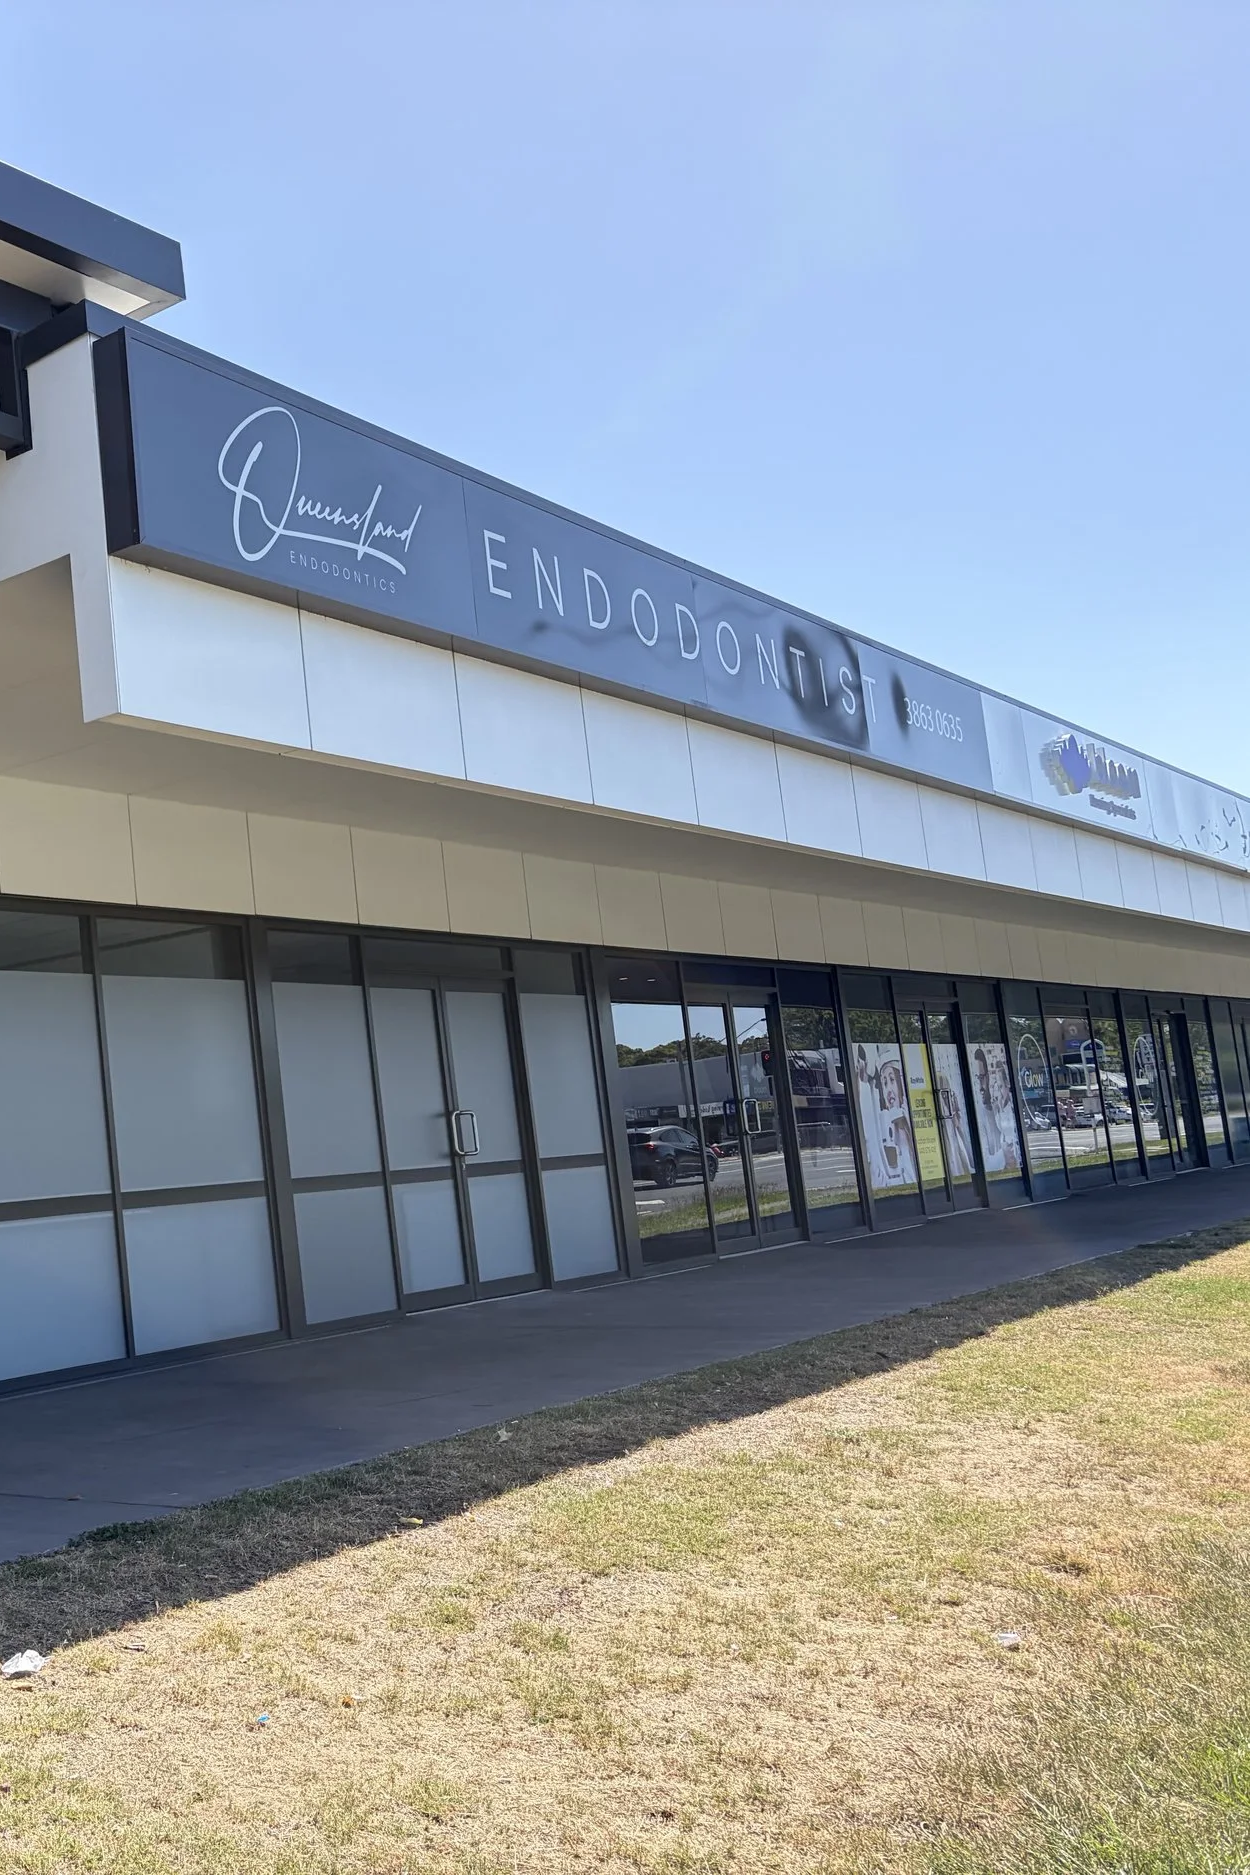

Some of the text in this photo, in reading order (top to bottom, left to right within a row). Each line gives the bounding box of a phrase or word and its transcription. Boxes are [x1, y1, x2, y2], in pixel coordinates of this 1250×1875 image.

[290, 550, 396, 594] ENDODONTICS
[483, 529, 877, 724] ENDODONTIST
[903, 697, 963, 742] 3863 0635
